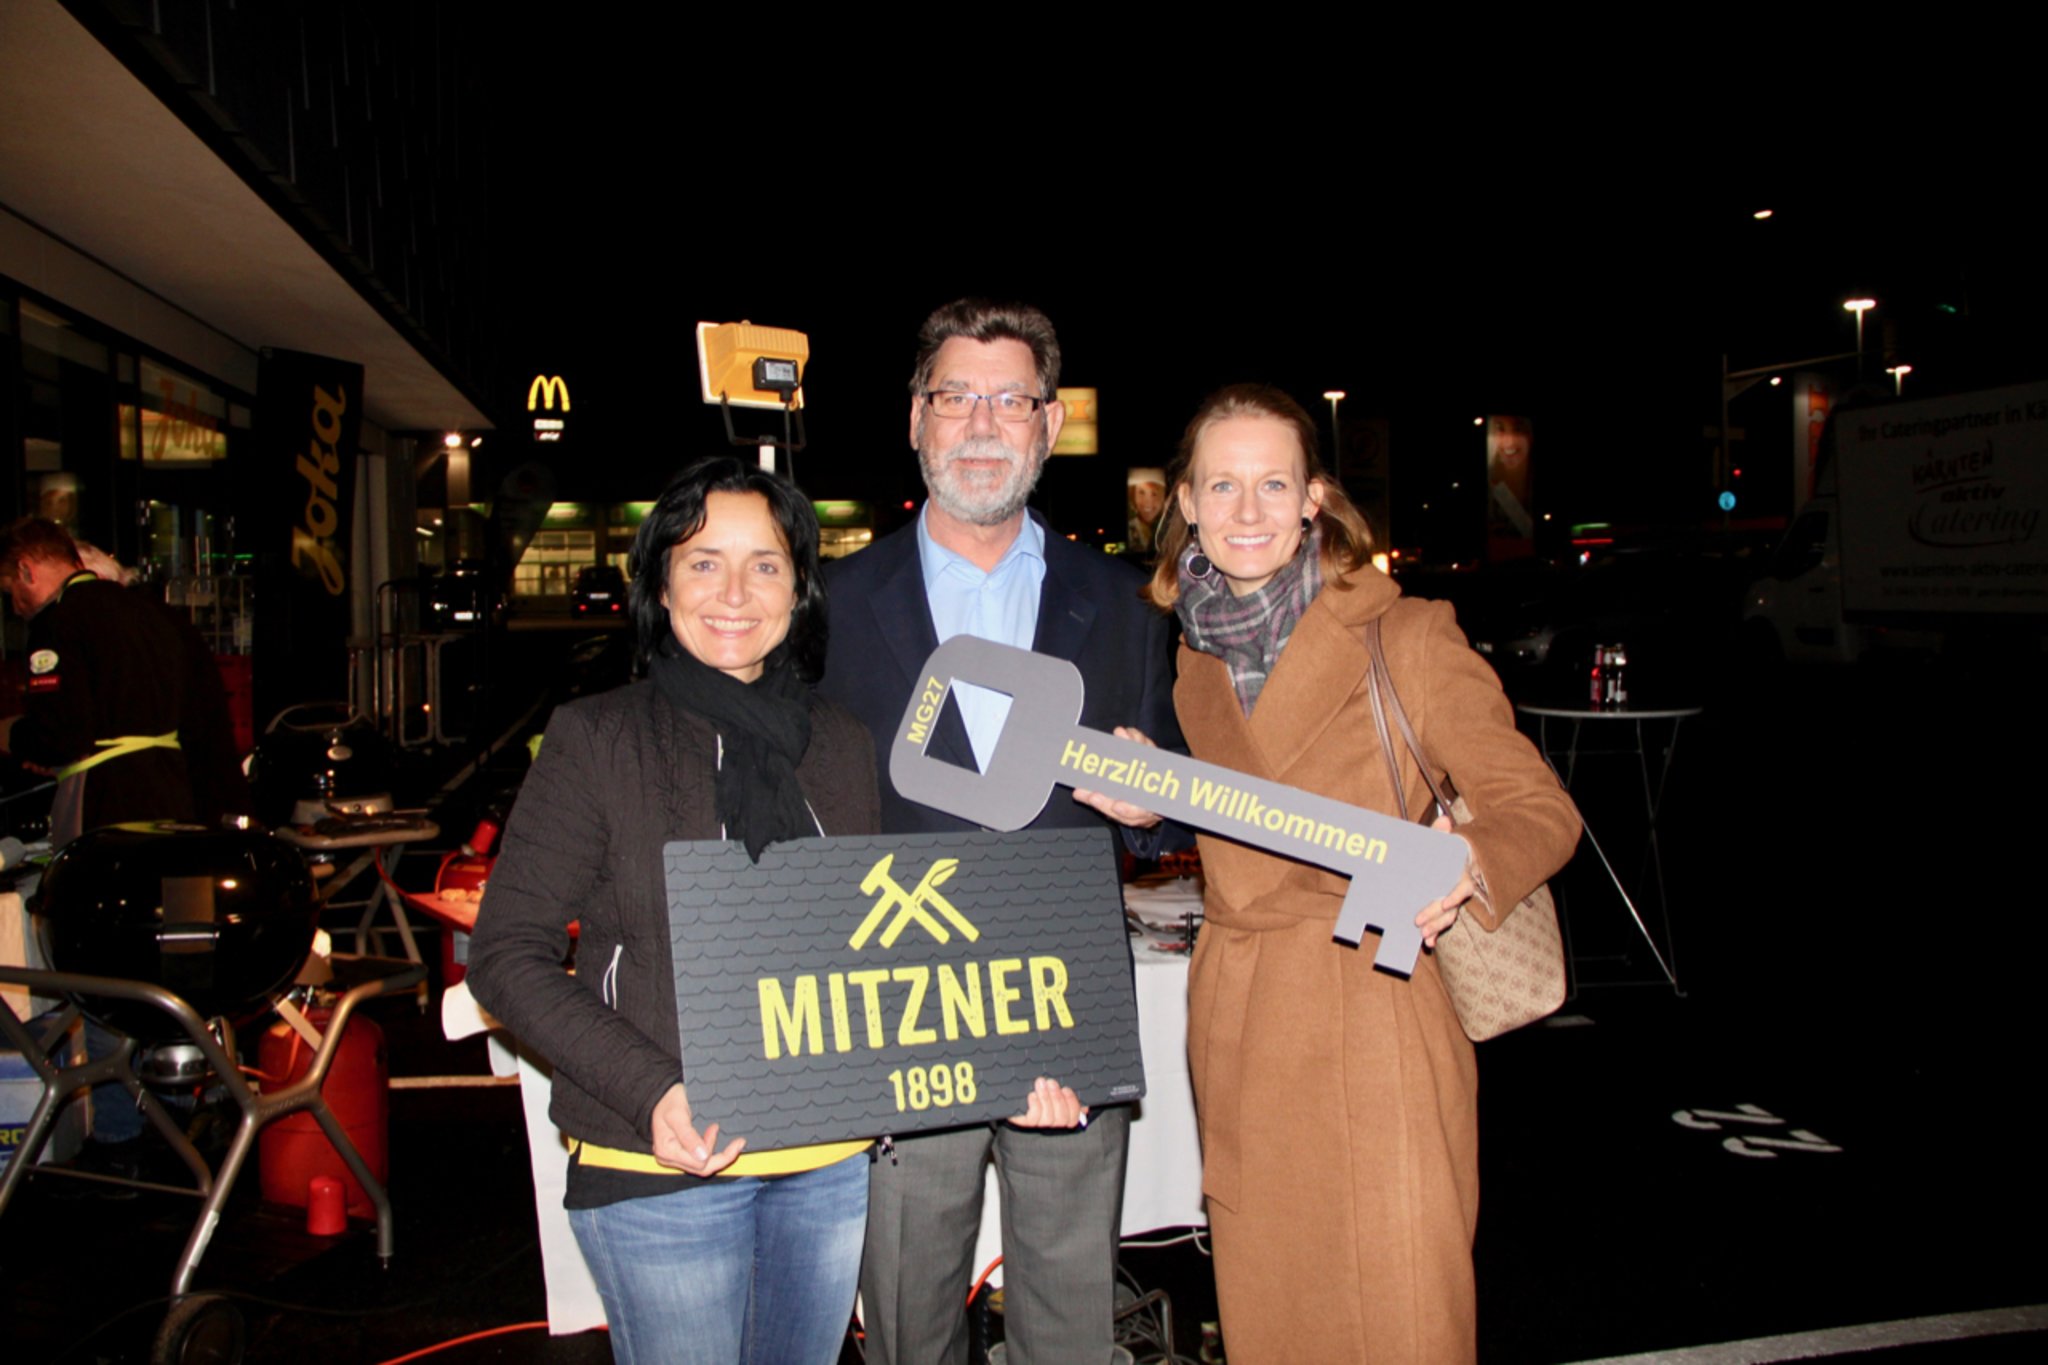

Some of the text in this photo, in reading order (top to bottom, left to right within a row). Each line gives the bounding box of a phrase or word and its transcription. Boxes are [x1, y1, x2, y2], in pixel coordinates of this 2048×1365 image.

[1881, 411, 2000, 439] Cateringpartner
[2005, 404, 2021, 423] in
[292, 384, 346, 596] Joka
[1908, 503, 2041, 548] Catering
[907, 676, 944, 744] MG27
[1060, 739, 1389, 864] Herzlich Willkommen
[758, 956, 1074, 1060] MITZNER
[888, 1061, 977, 1112] 1898
